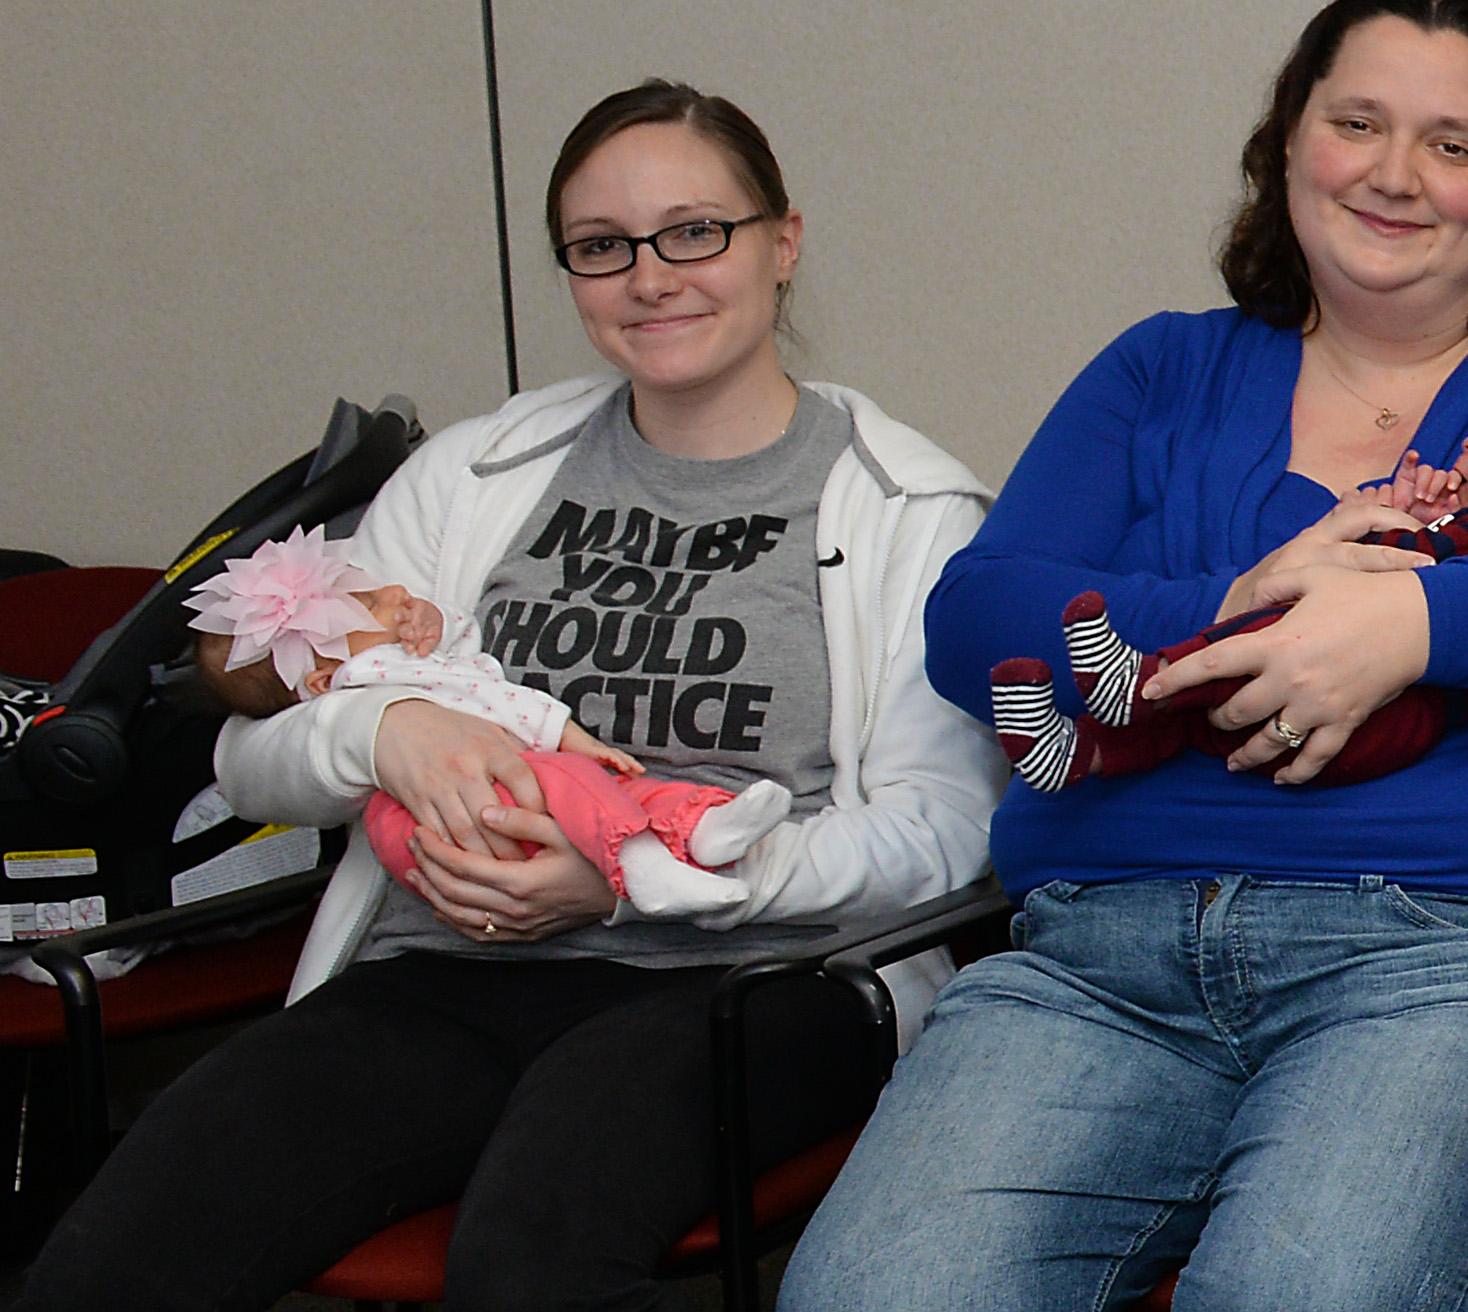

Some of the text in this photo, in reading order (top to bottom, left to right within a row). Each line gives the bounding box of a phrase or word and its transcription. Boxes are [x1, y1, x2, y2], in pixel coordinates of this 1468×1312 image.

[527, 499, 788, 572] MAYBE
[550, 554, 712, 616] YOU
[481, 599, 747, 676] SHOULD
